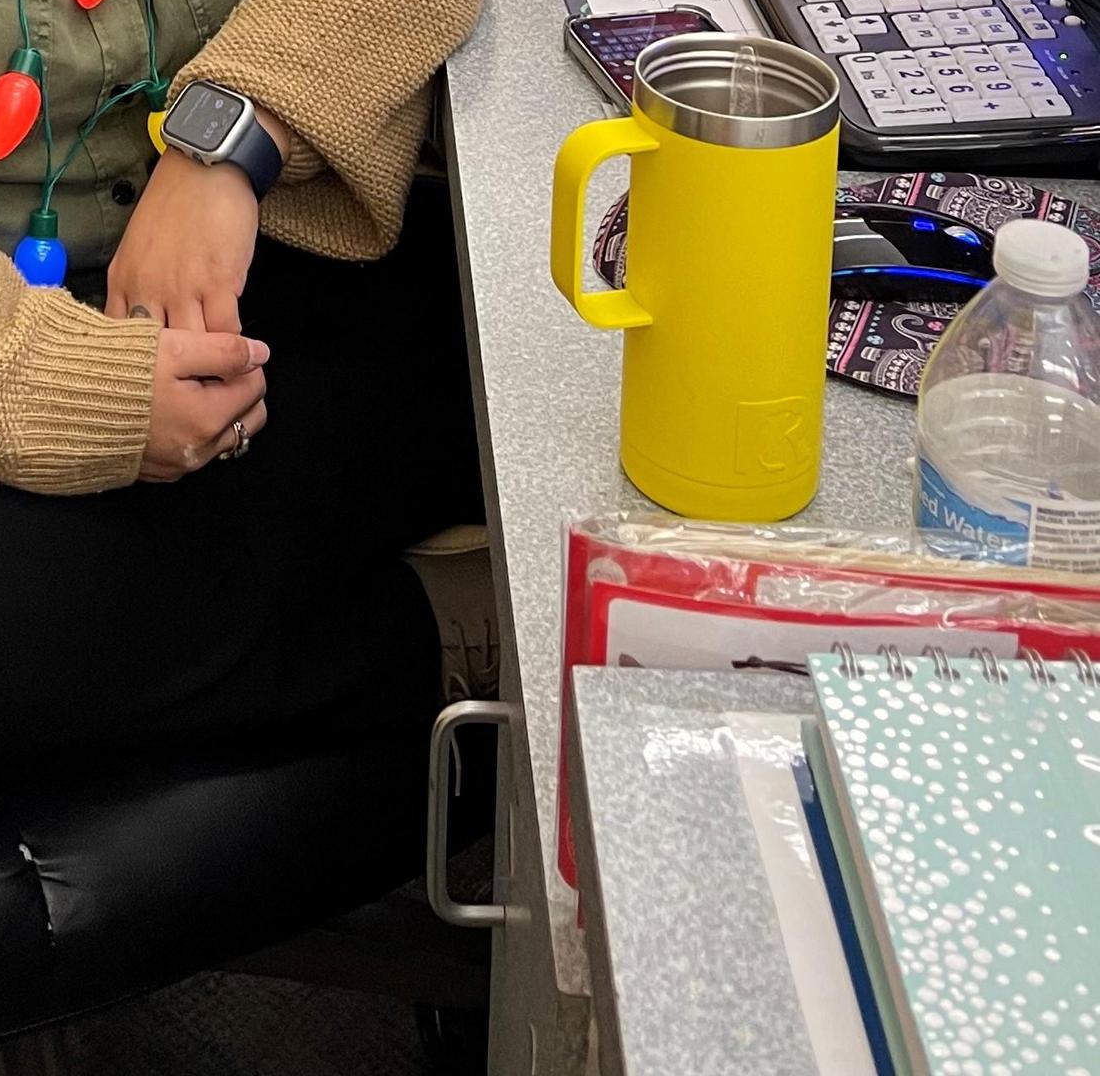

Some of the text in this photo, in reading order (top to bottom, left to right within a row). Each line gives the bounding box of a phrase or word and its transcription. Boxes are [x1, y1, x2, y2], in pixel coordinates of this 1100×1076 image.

[938, 68, 964, 76] 5
[974, 65, 1000, 73] 8
[898, 70, 925, 78] 2
[948, 85, 974, 93] 6
[986, 82, 1012, 90] 9
[910, 87, 936, 96] 3
[921, 491, 939, 517] ed
[944, 506, 1012, 547] Water
